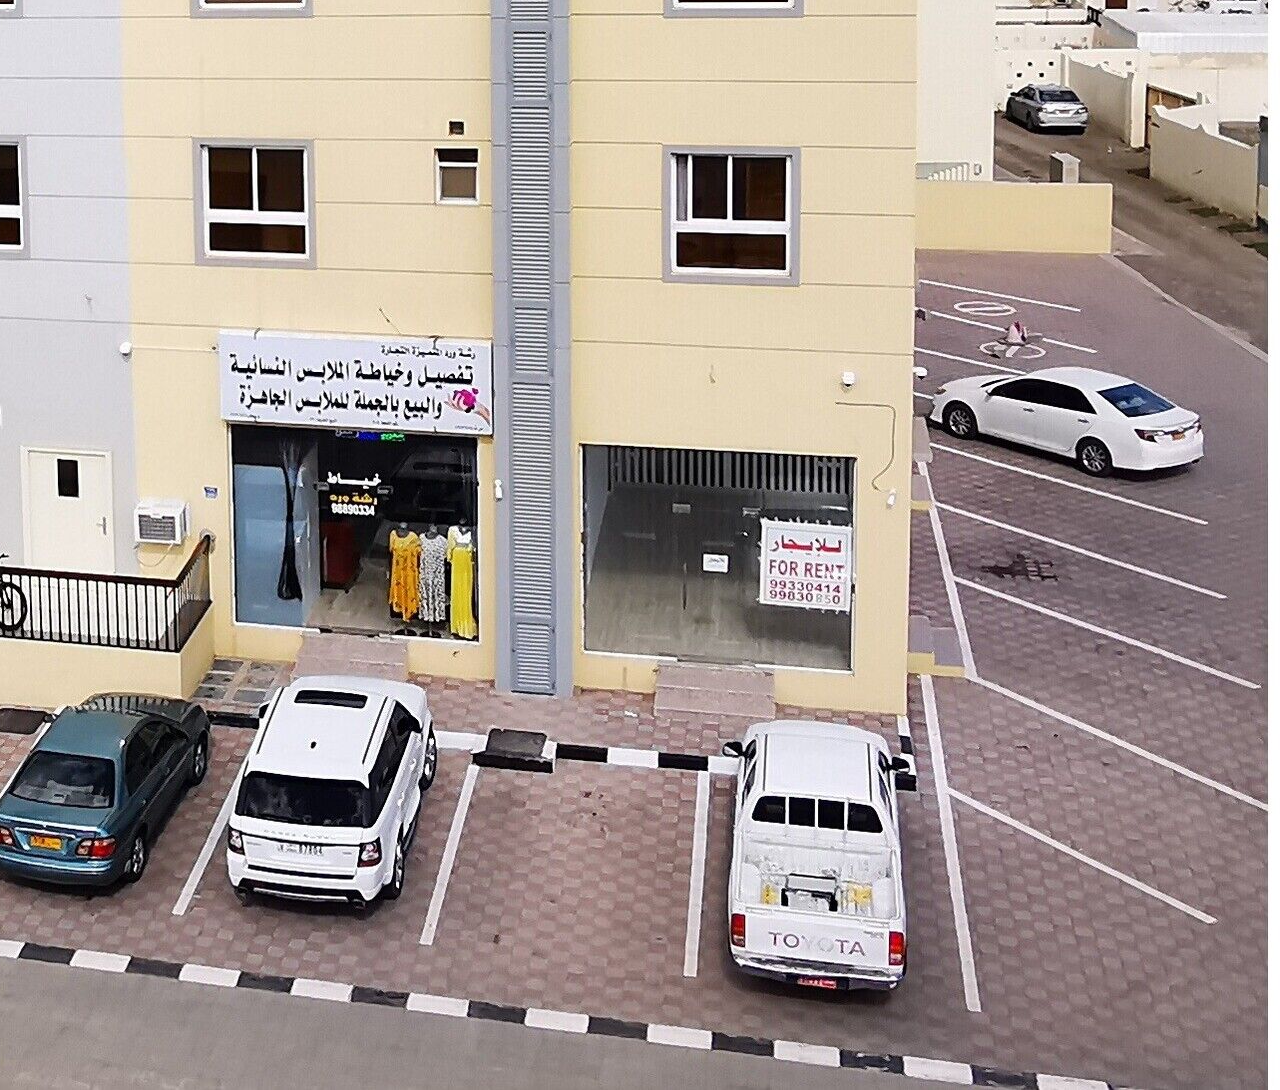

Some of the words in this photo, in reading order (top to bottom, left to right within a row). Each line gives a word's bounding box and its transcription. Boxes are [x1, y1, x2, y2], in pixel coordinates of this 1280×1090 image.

[230, 353, 292, 380] النسائية
[296, 358, 350, 385] الملابس
[354, 359, 413, 387] وخياطة
[417, 363, 475, 389] تفصيل
[239, 384, 292, 412] الجاهزة
[295, 388, 350, 416] للملابس
[354, 389, 399, 418] بالجملة
[403, 397, 443, 420] والبيع
[768, 559, 798, 577] FOR
[804, 562, 846, 580] RENT
[769, 579, 842, 594] 99330414
[768, 930, 866, 956] TOYOTA
